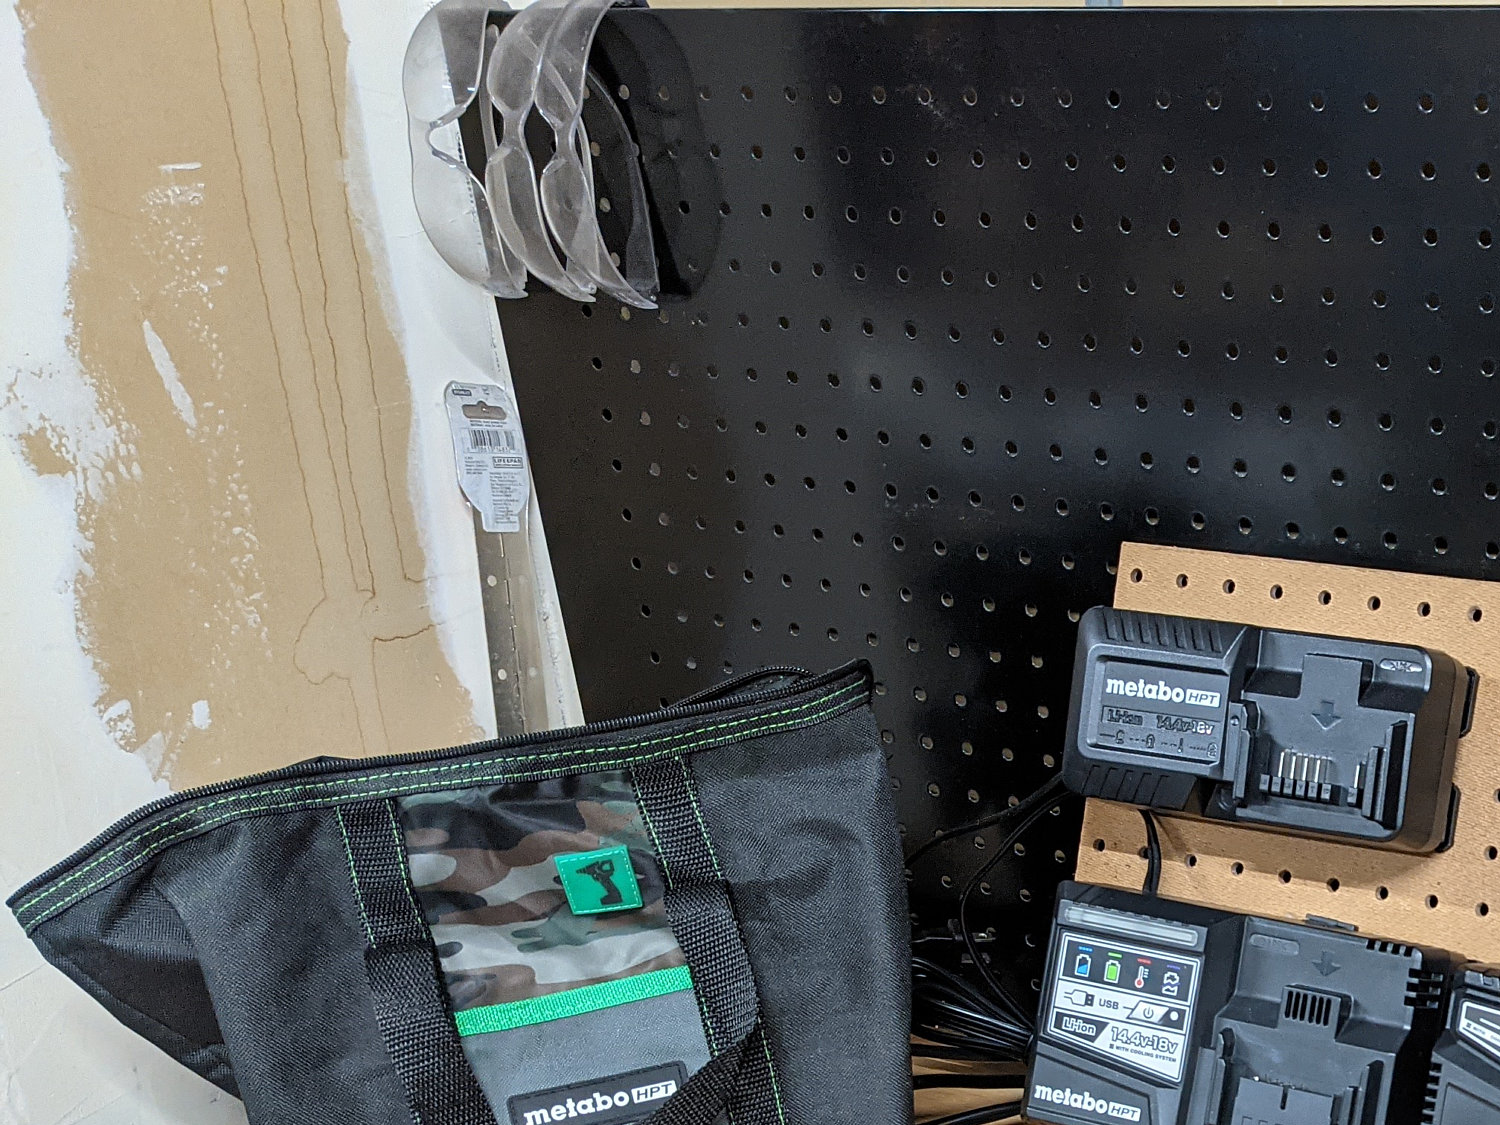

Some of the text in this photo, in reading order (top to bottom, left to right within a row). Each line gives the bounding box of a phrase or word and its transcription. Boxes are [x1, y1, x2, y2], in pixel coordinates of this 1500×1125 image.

[1106, 678, 1219, 706] metabo HPT
[1099, 998, 1119, 1010] USB
[1062, 1016, 1097, 1036] Li-ion
[1111, 1026, 1178, 1054] 14.4v-18v
[1130, 1048, 1154, 1058] COOLING
[1155, 1053, 1177, 1062] SYSTEM
[634, 1082, 675, 1102] HPT
[1034, 1084, 1139, 1120] metabo HPT
